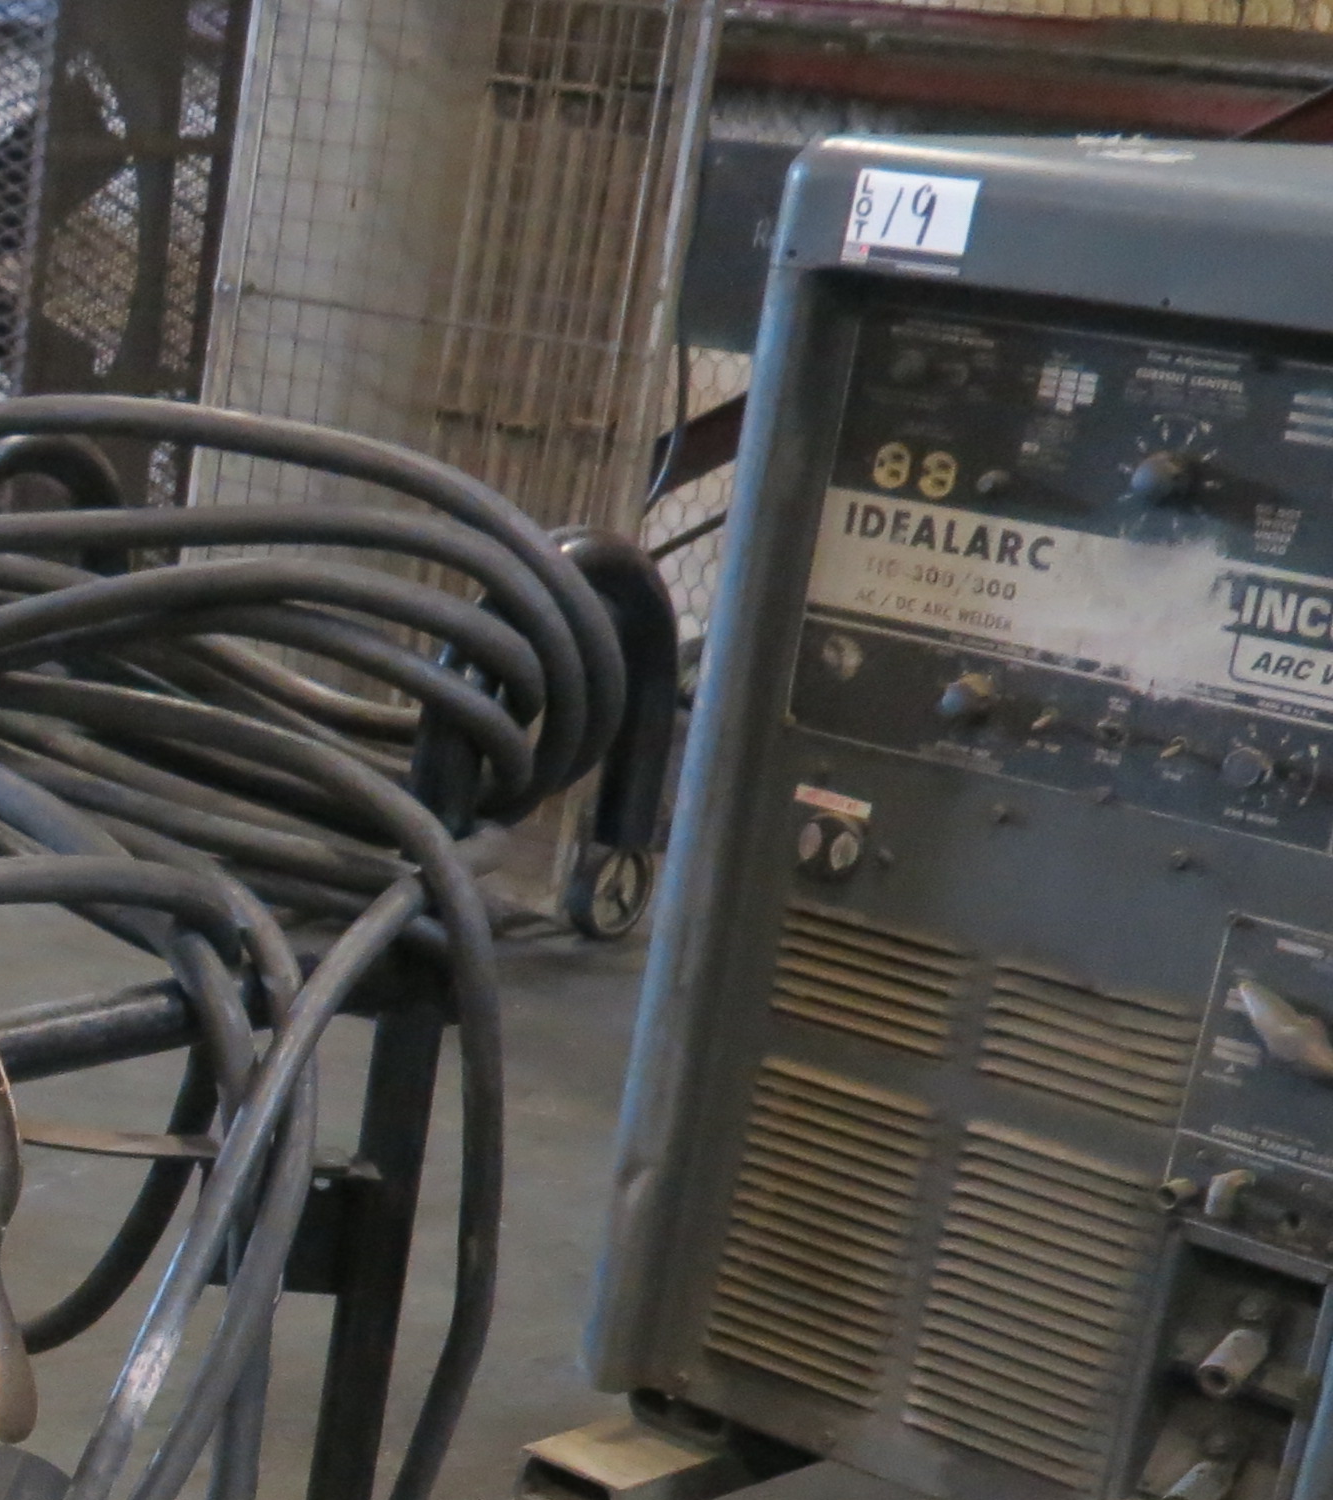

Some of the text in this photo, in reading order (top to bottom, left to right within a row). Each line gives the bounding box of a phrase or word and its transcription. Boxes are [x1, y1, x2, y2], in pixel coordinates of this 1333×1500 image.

[854, 172, 874, 241] LOT
[880, 182, 938, 247] 19
[843, 501, 1055, 572] IDEALARC
[921, 600, 952, 622] ARC
[957, 607, 1013, 632] WELDER
[1250, 651, 1316, 681] ARC
